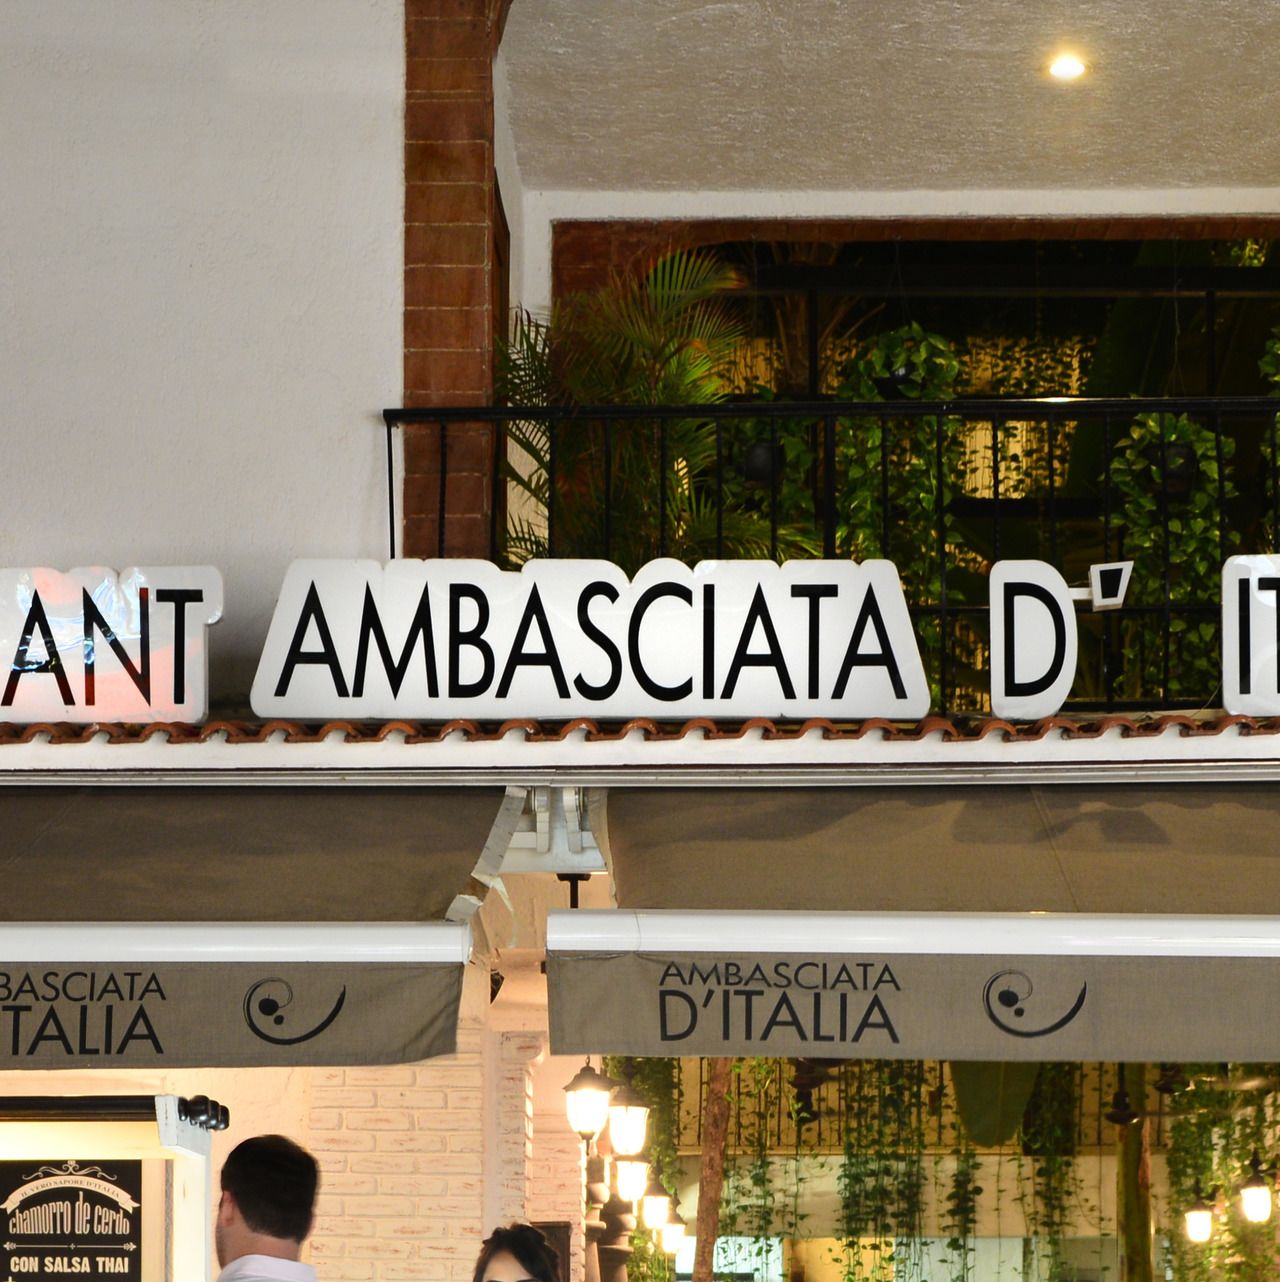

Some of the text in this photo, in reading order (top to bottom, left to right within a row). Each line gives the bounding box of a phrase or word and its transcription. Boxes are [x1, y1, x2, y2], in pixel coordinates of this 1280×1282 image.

[274, 580, 908, 702] AMBASCIATA
[1003, 567, 1124, 697] D'
[659, 961, 902, 992] AMBASCIATA
[659, 989, 901, 1043] D'ITALIA
[9, 1191, 130, 1235] chamorro de cerdo
[10, 1256, 129, 1273] CON SALSA THAI
